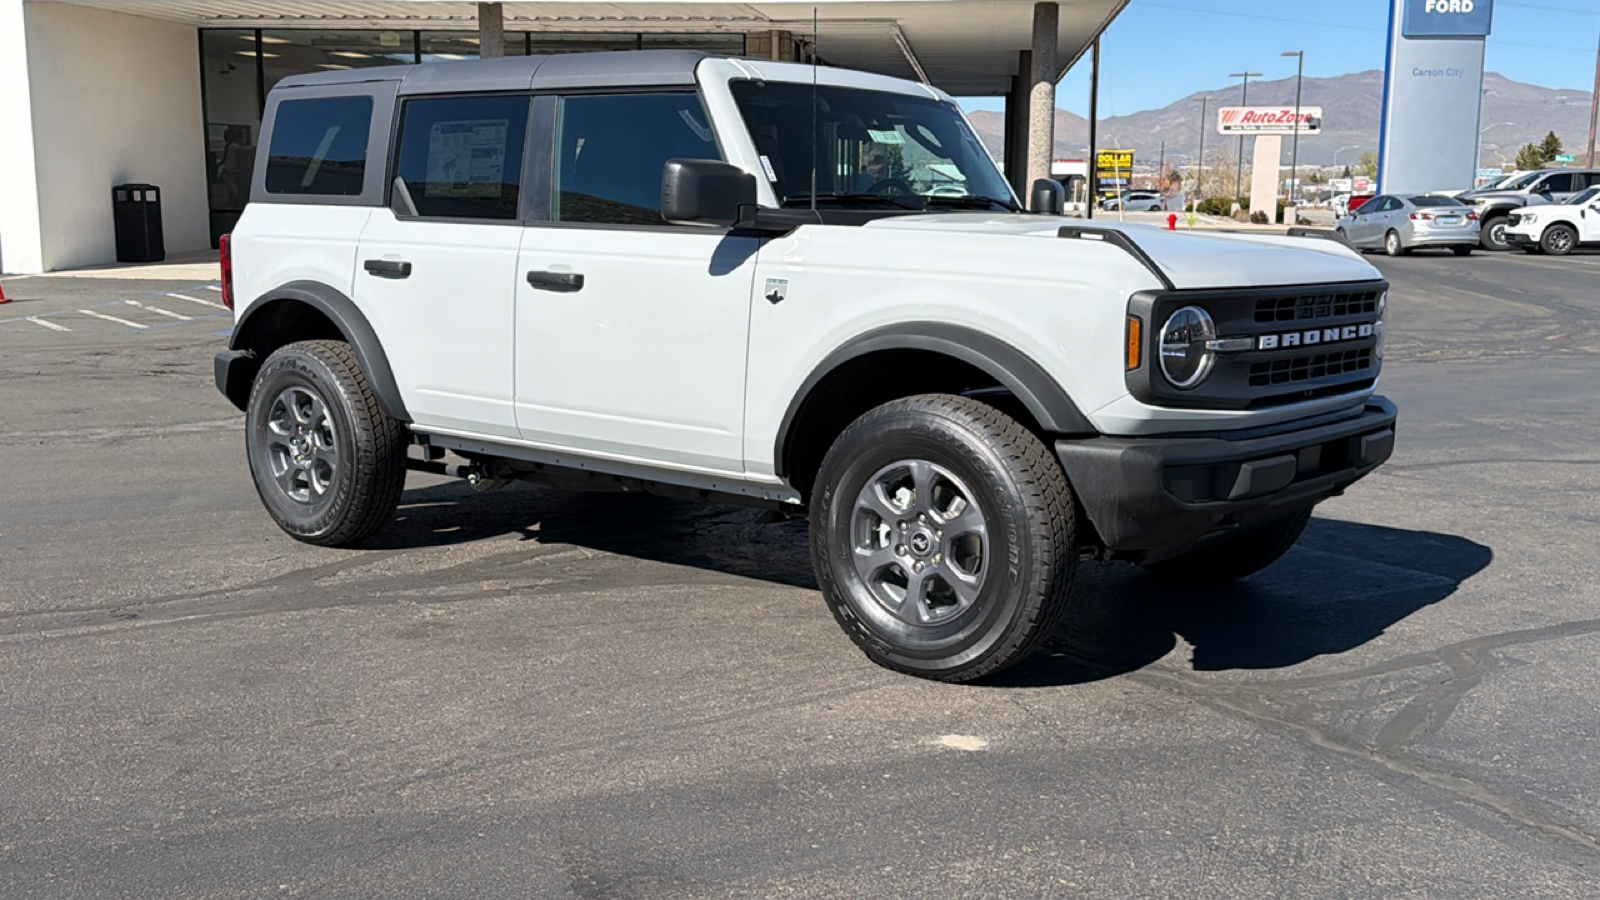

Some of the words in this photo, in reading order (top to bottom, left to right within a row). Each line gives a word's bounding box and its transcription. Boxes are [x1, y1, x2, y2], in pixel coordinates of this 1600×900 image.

[1425, 0, 1474, 13] FORD
[1412, 67, 1444, 77] Carson
[1445, 67, 1465, 79] City
[1241, 110, 1312, 123] AutoZone
[1098, 154, 1131, 162] DOLLAR
[1259, 324, 1373, 350] BRONCO
